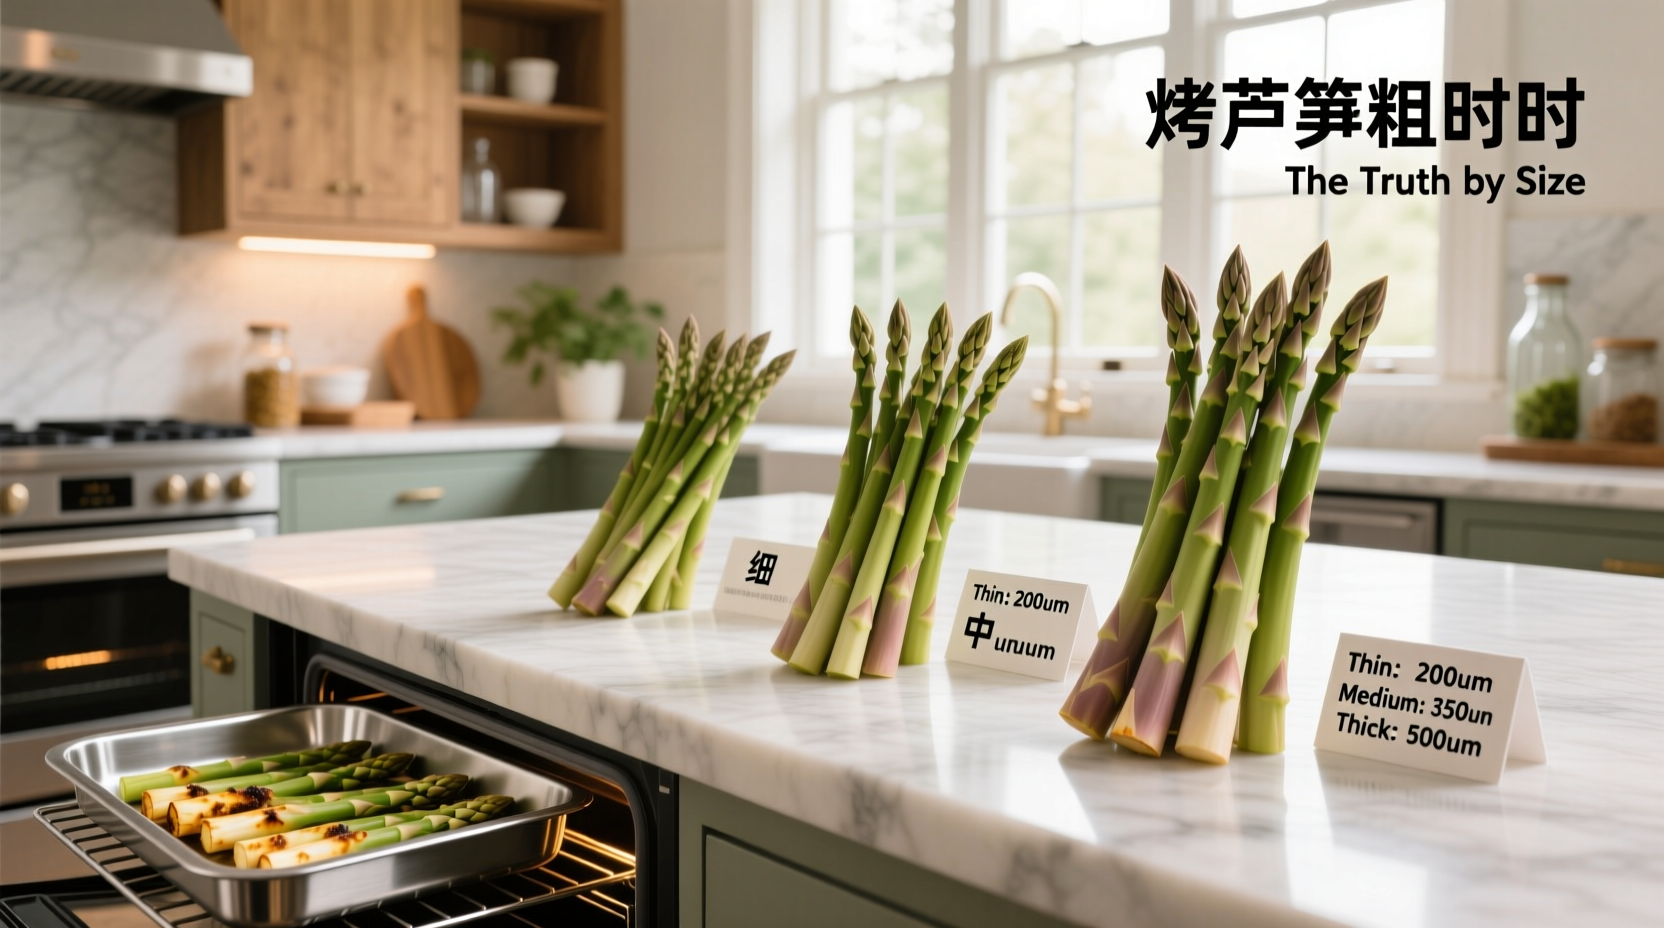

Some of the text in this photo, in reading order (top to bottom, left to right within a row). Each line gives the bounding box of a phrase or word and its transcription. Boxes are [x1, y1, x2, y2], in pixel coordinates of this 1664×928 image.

[745, 550, 778, 586] 细
[973, 583, 1070, 615] Thin: 200um
[963, 611, 995, 650] 中
[1348, 651, 1493, 693] Thin: 200um
[1338, 682, 1493, 726] Medium: 350un
[1337, 711, 1482, 757] Thick: 500um
